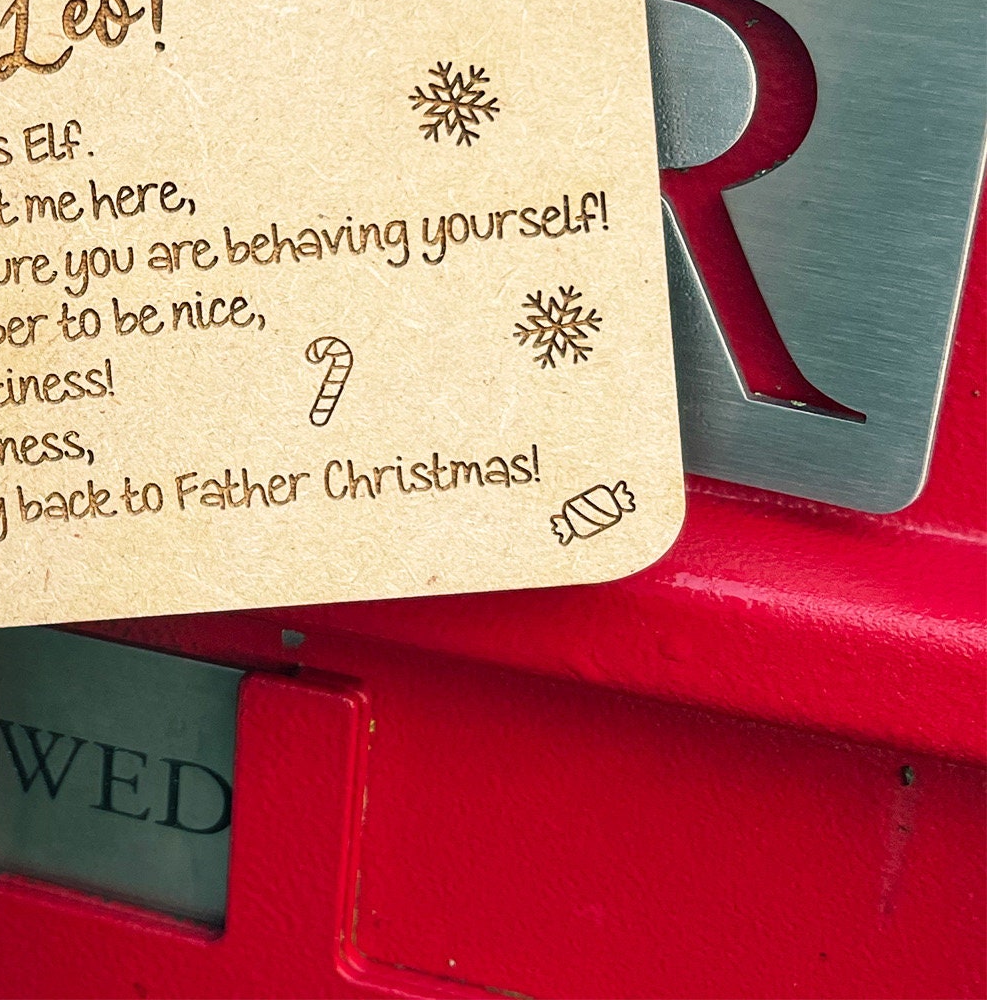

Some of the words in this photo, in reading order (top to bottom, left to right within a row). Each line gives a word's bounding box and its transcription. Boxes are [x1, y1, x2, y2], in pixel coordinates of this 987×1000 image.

[22, 119, 95, 165] Elf.
[25, 189, 85, 225] me
[88, 178, 197, 221] here,
[64, 245, 135, 299] you
[146, 237, 219, 275] are
[223, 215, 410, 268] behaving
[421, 190, 610, 266] yourself!
[57, 301, 102, 343] to
[111, 297, 165, 337] be
[171, 290, 266, 331] nice,
[16, 479, 118, 523] back
[119, 476, 165, 517] to
[174, 467, 311, 511] Father
[323, 443, 542, 502] Christmas!
